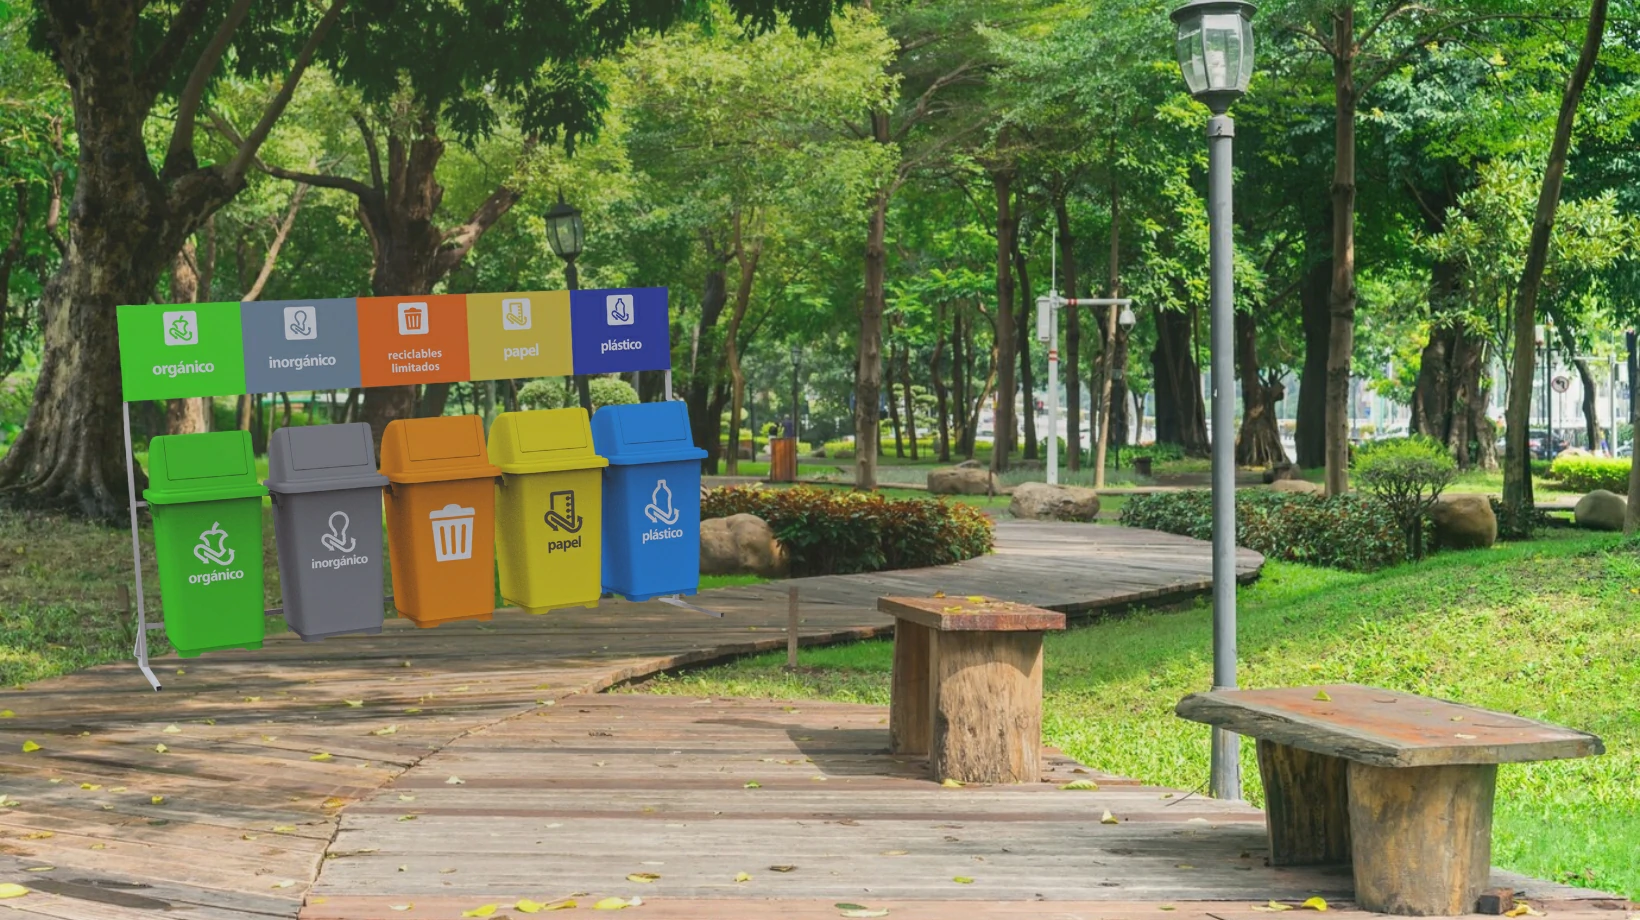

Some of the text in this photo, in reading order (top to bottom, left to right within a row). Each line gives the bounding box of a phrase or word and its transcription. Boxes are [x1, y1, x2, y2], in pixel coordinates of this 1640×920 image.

[388, 348, 442, 360] reciclables
[504, 343, 540, 361] papel
[601, 339, 642, 354] plástico
[152, 360, 214, 378] orgánico
[269, 354, 336, 370] inorgánico
[391, 361, 440, 373] limitados
[642, 528, 683, 544] plástico
[548, 536, 581, 553] papel
[311, 554, 368, 569] inorgánico
[189, 568, 244, 585] orgánico
